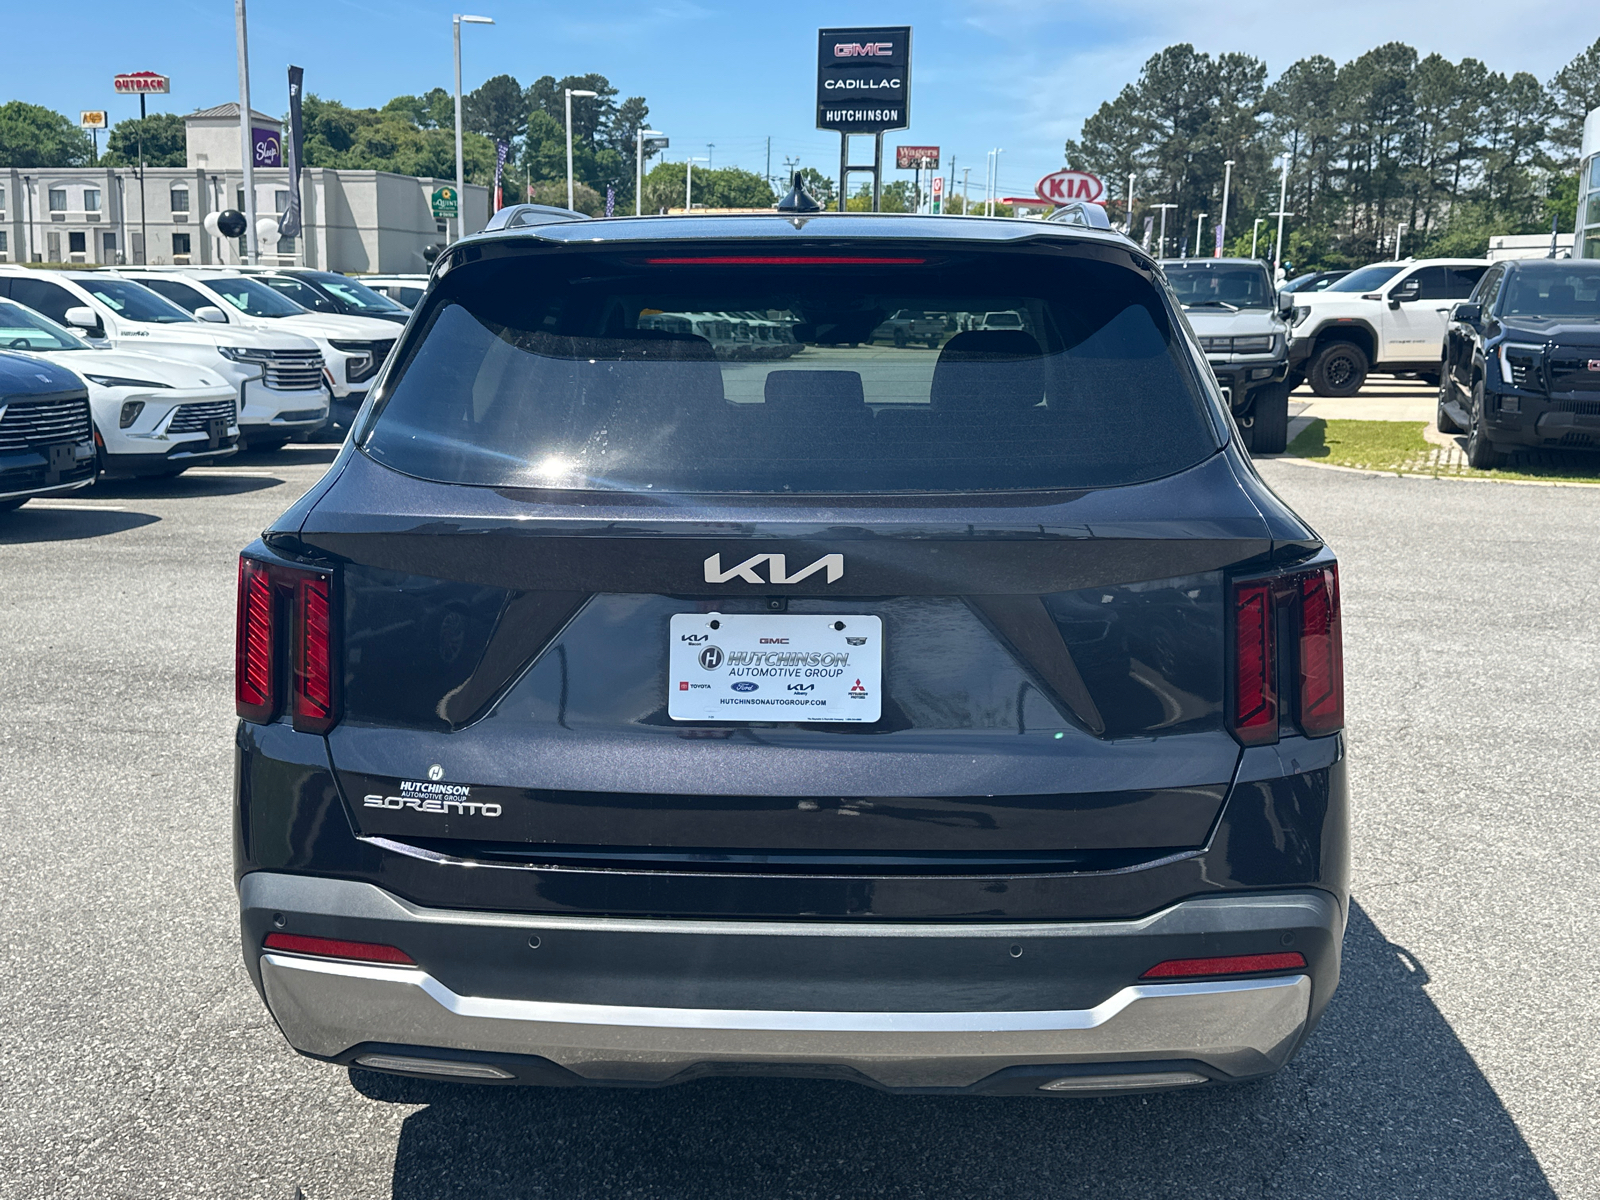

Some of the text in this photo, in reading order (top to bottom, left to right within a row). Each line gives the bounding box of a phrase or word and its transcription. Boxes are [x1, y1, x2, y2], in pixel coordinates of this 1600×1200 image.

[834, 43, 893, 57] GMC
[115, 80, 164, 90] OUTBACK
[824, 79, 901, 89] CADILLAC
[826, 110, 898, 121] HUTCHINSON
[256, 142, 277, 161] Sleep
[899, 147, 938, 158] Wagers
[1050, 179, 1092, 198] KIA
[704, 553, 844, 584] KIA
[727, 652, 850, 668] HUTCHINSON
[729, 667, 844, 678] AUTOMOTIVE GROUP
[736, 683, 754, 691] Ford
[720, 698, 827, 706] HUTCHINSONAUTOGROUP.COM
[400, 781, 470, 796] HUTCHINSON
[401, 791, 467, 802] AUTOMOTIVE GROUP
[363, 794, 502, 817] SORENTO
